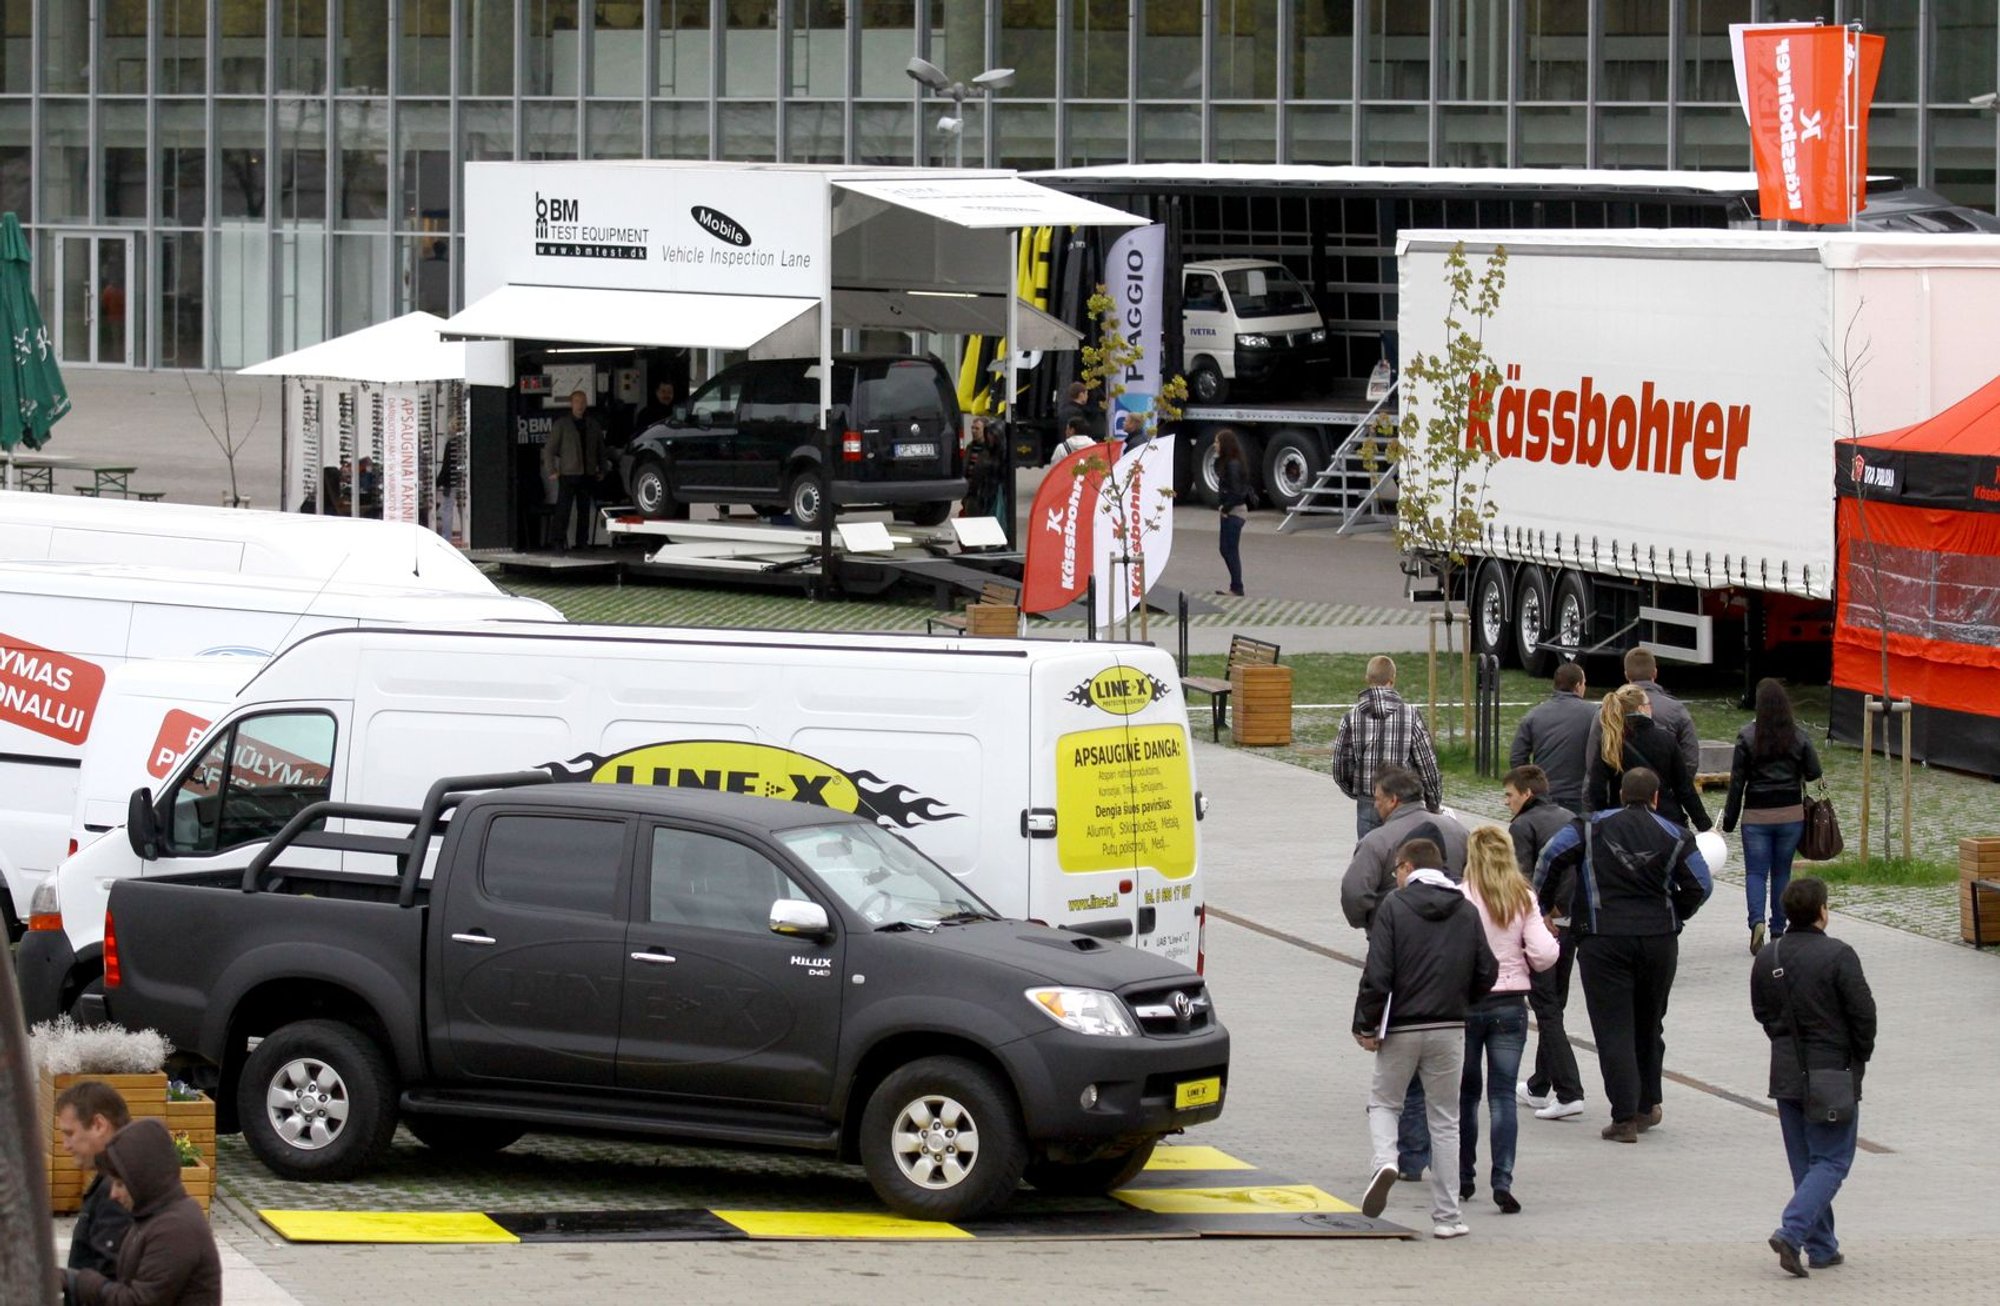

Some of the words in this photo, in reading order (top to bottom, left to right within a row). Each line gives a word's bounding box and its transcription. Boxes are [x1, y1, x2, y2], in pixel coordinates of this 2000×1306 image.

[550, 199, 578, 222] BM
[551, 226, 578, 240] TEST
[582, 227, 649, 242] EQUIPMENT
[700, 209, 744, 244] Mobile
[537, 246, 645, 258] www.bmtest.dk
[662, 245, 704, 263] Vehicle
[710, 247, 774, 269] Inspection
[781, 249, 811, 268] Lane
[1126, 249, 1144, 383] PAGGIO
[529, 418, 552, 432] BM
[1466, 364, 1751, 481] Kässbohrer
[1062, 458, 1086, 590] Kässbohr
[1074, 738, 1141, 767] APSAUGINĖ
[1145, 738, 1181, 761] DANGA:
[790, 955, 832, 968] HILUX
